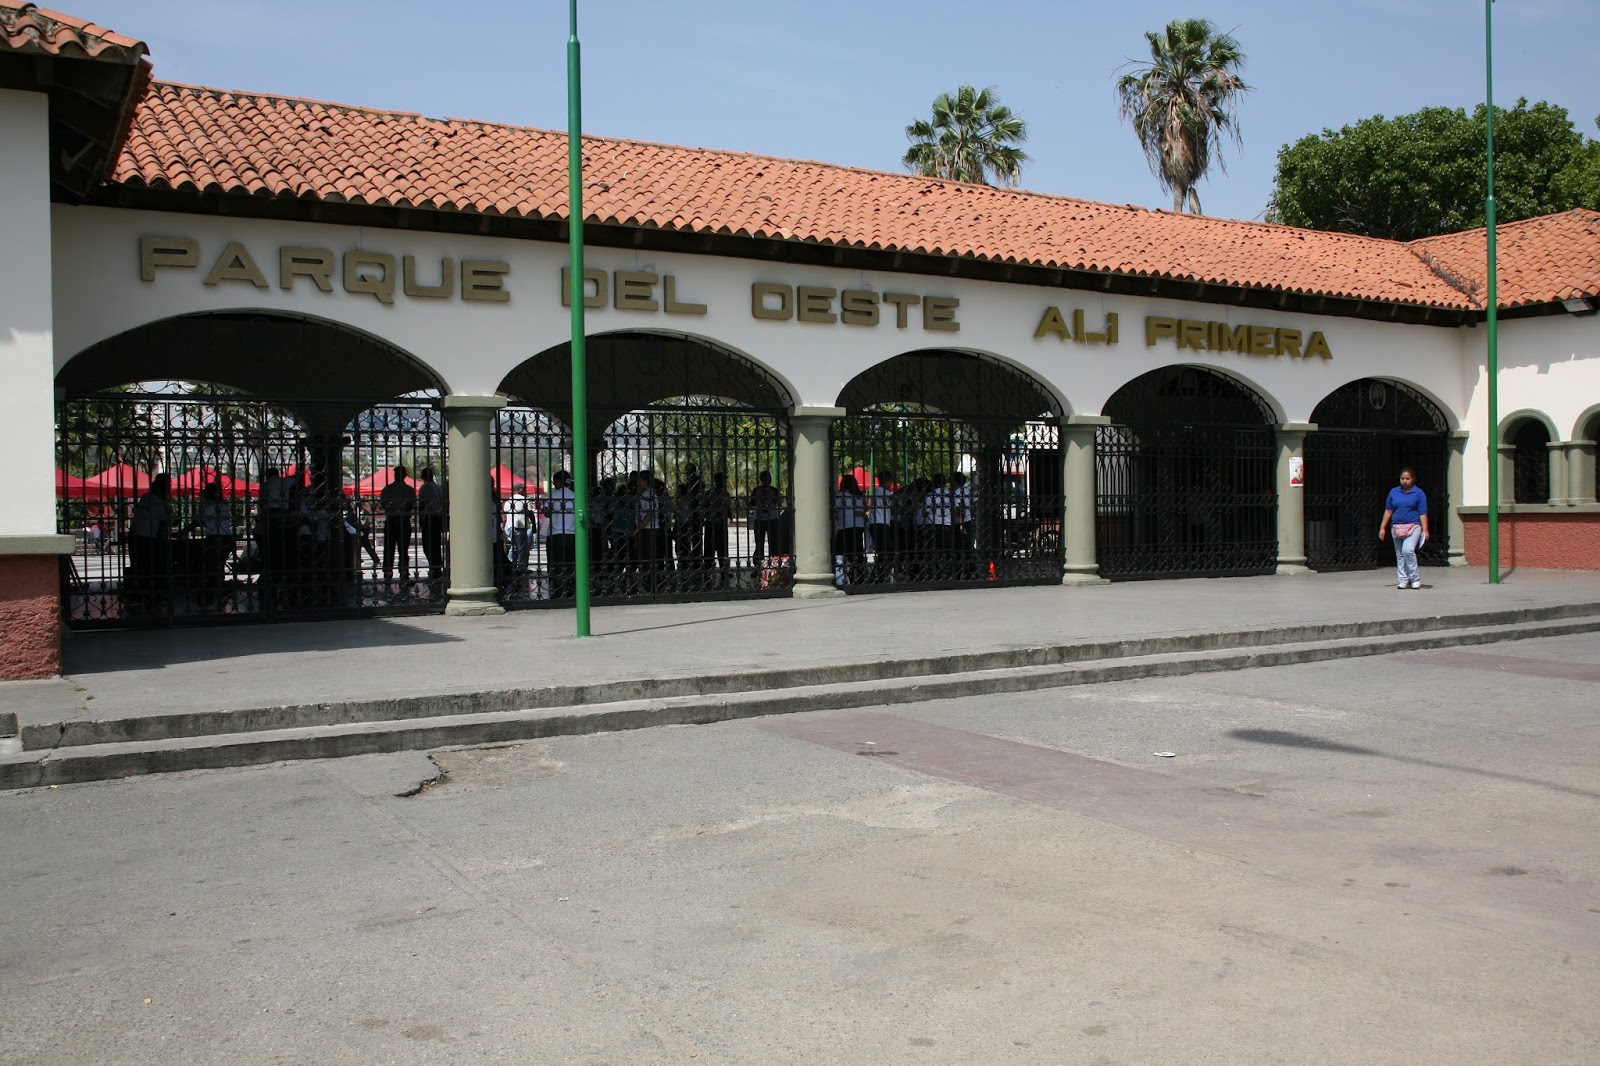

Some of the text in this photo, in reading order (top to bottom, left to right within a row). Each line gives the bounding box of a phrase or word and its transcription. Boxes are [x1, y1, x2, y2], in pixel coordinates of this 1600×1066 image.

[139, 236, 1334, 360] PARQUE DEL OESTE ALI PRIMERA
